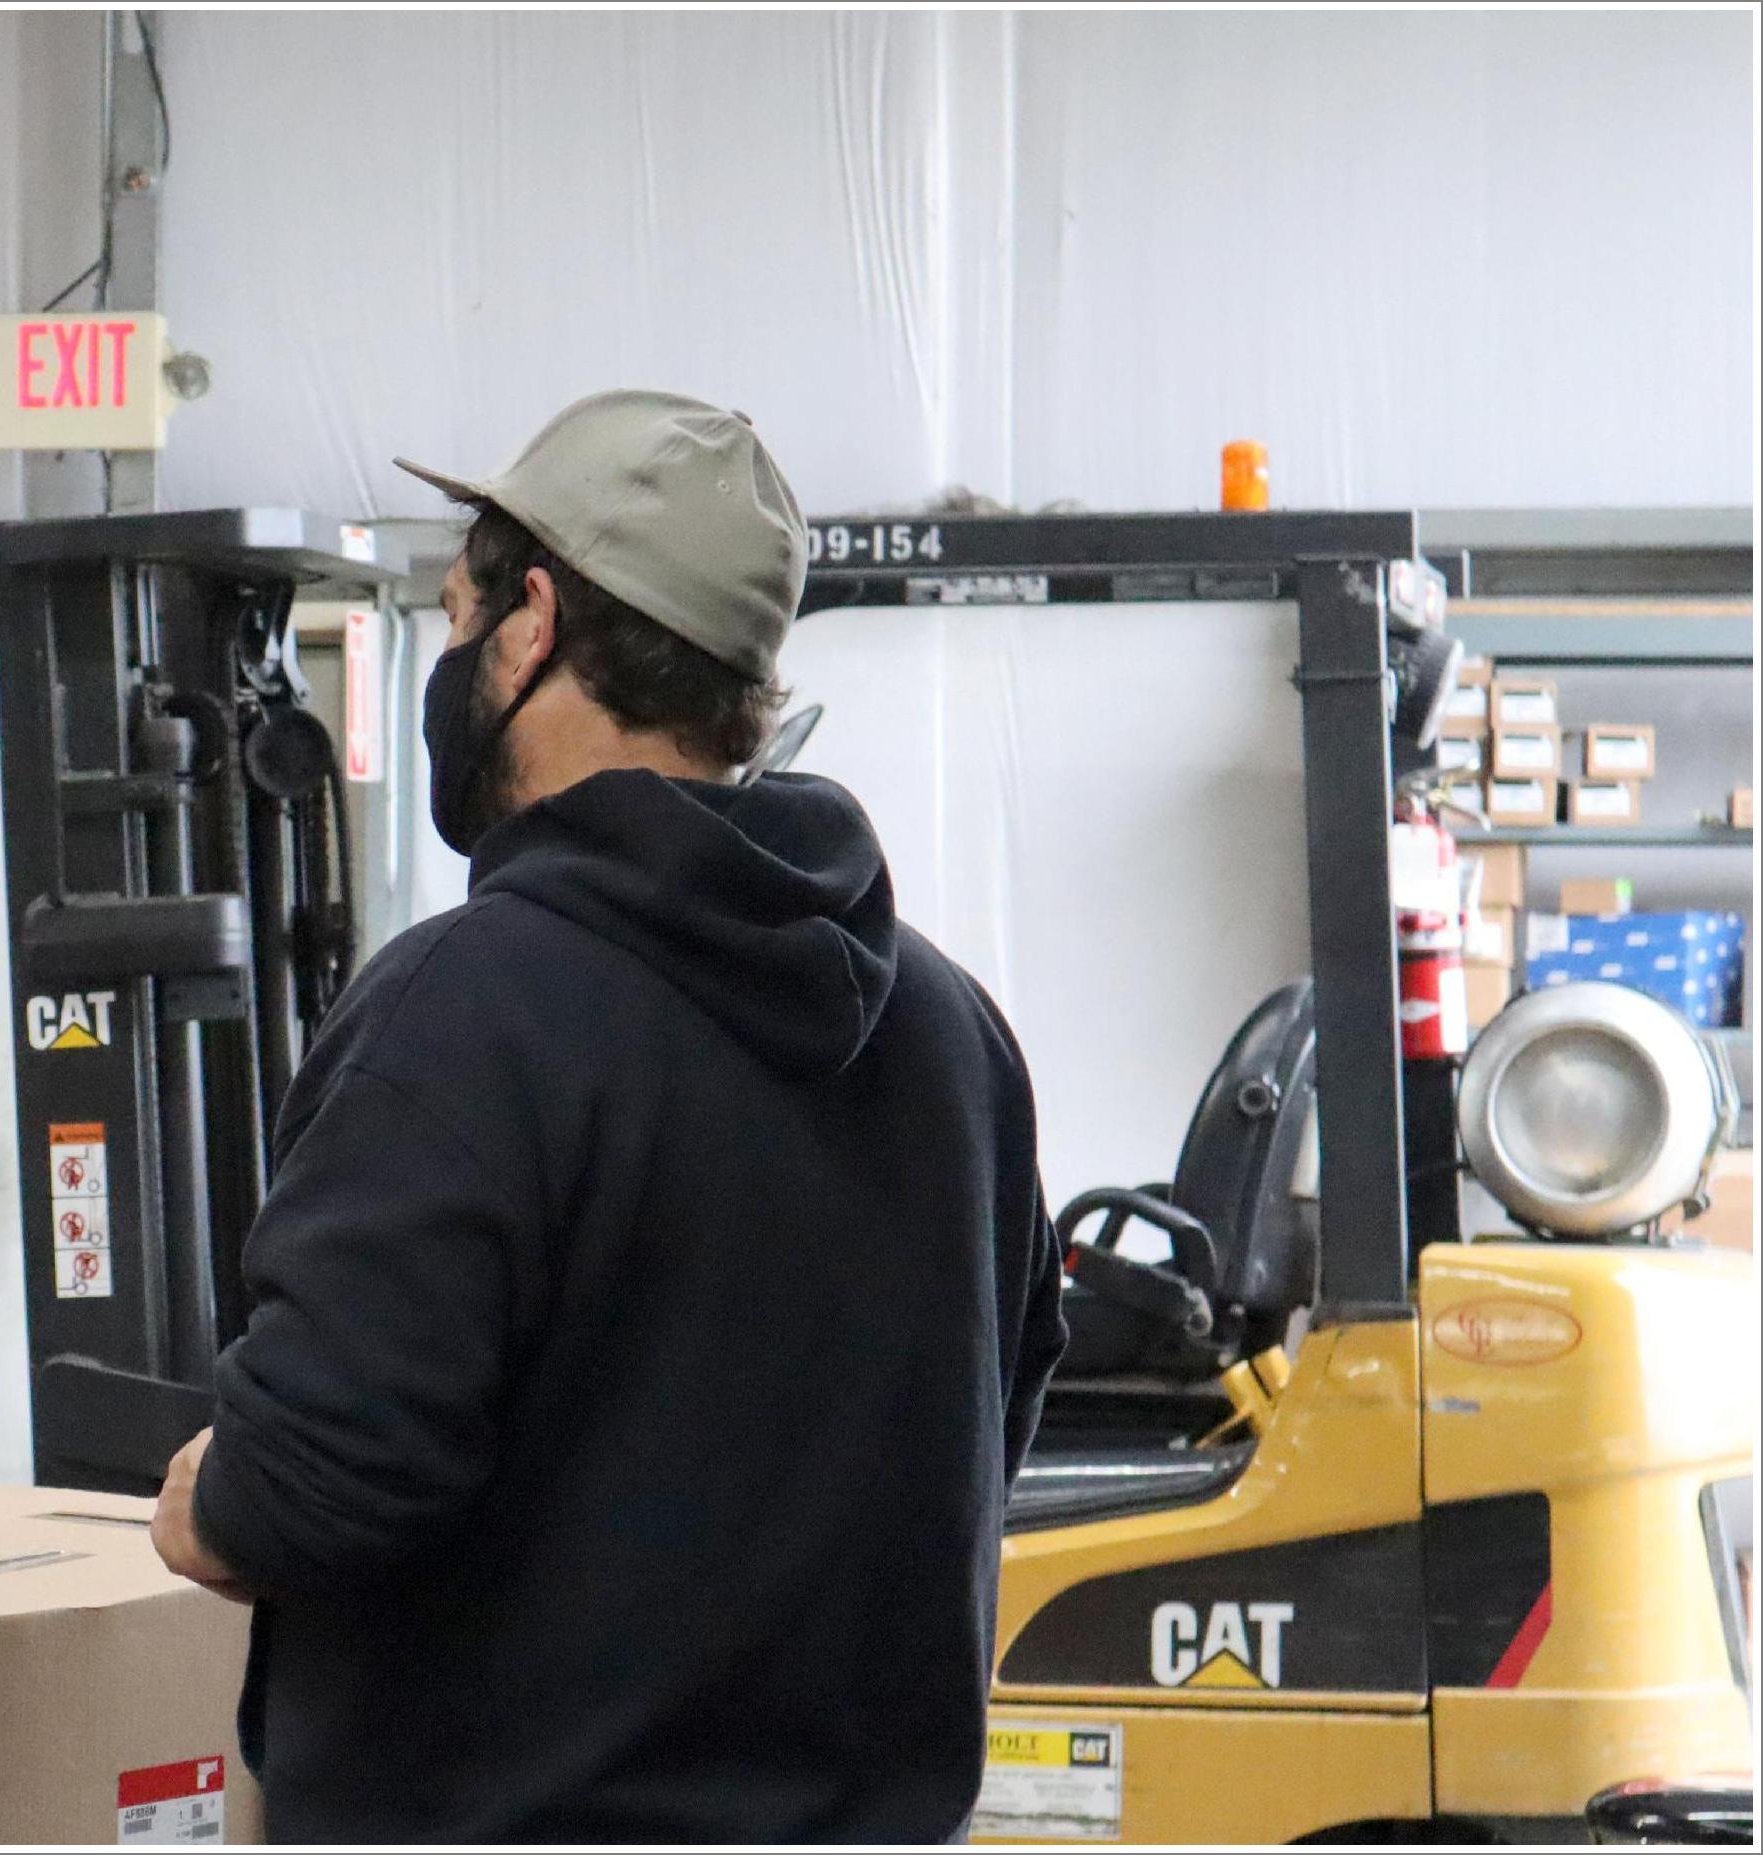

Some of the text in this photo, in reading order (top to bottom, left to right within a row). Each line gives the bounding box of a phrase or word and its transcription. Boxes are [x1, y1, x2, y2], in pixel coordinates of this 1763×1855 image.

[18, 323, 135, 408] EXIT
[26, 991, 115, 1050] CAT
[1150, 1602, 1294, 1689] CAT
